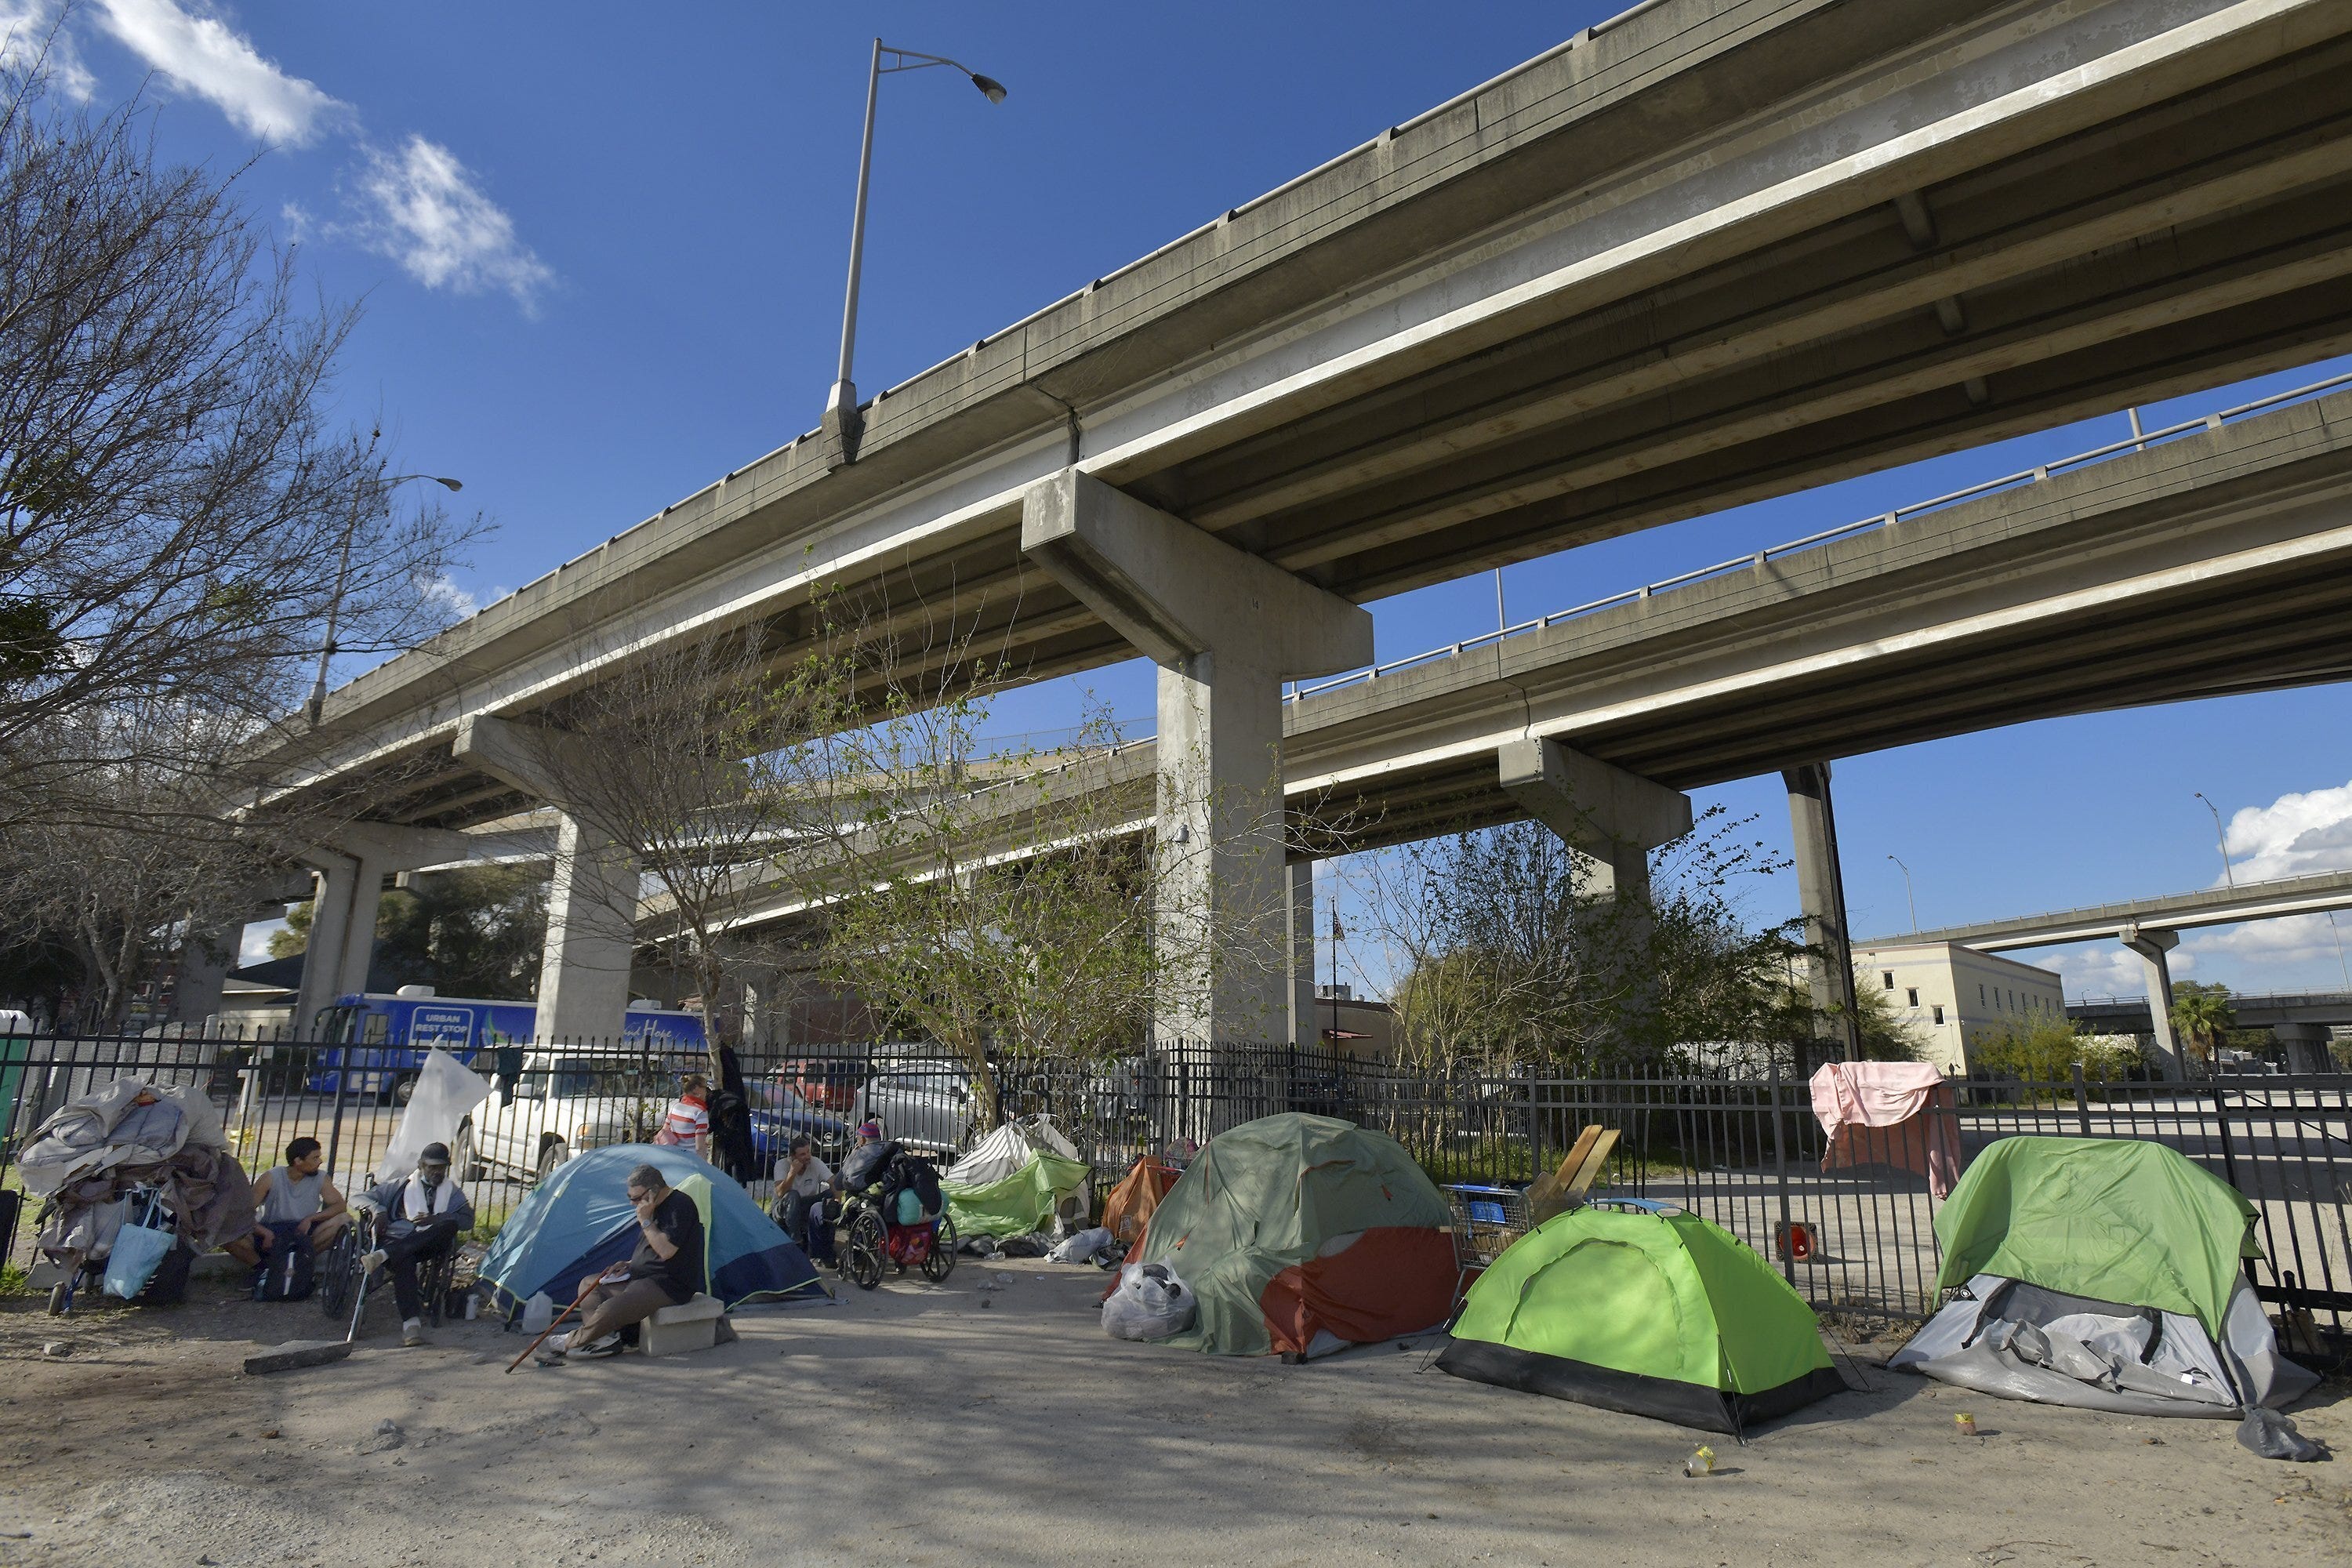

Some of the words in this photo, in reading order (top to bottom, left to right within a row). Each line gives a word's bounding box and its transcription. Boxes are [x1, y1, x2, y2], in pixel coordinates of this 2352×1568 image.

[426, 1014, 460, 1022] URBAN
[442, 1025, 468, 1033] STOP
[643, 1018, 672, 1040] Hope
